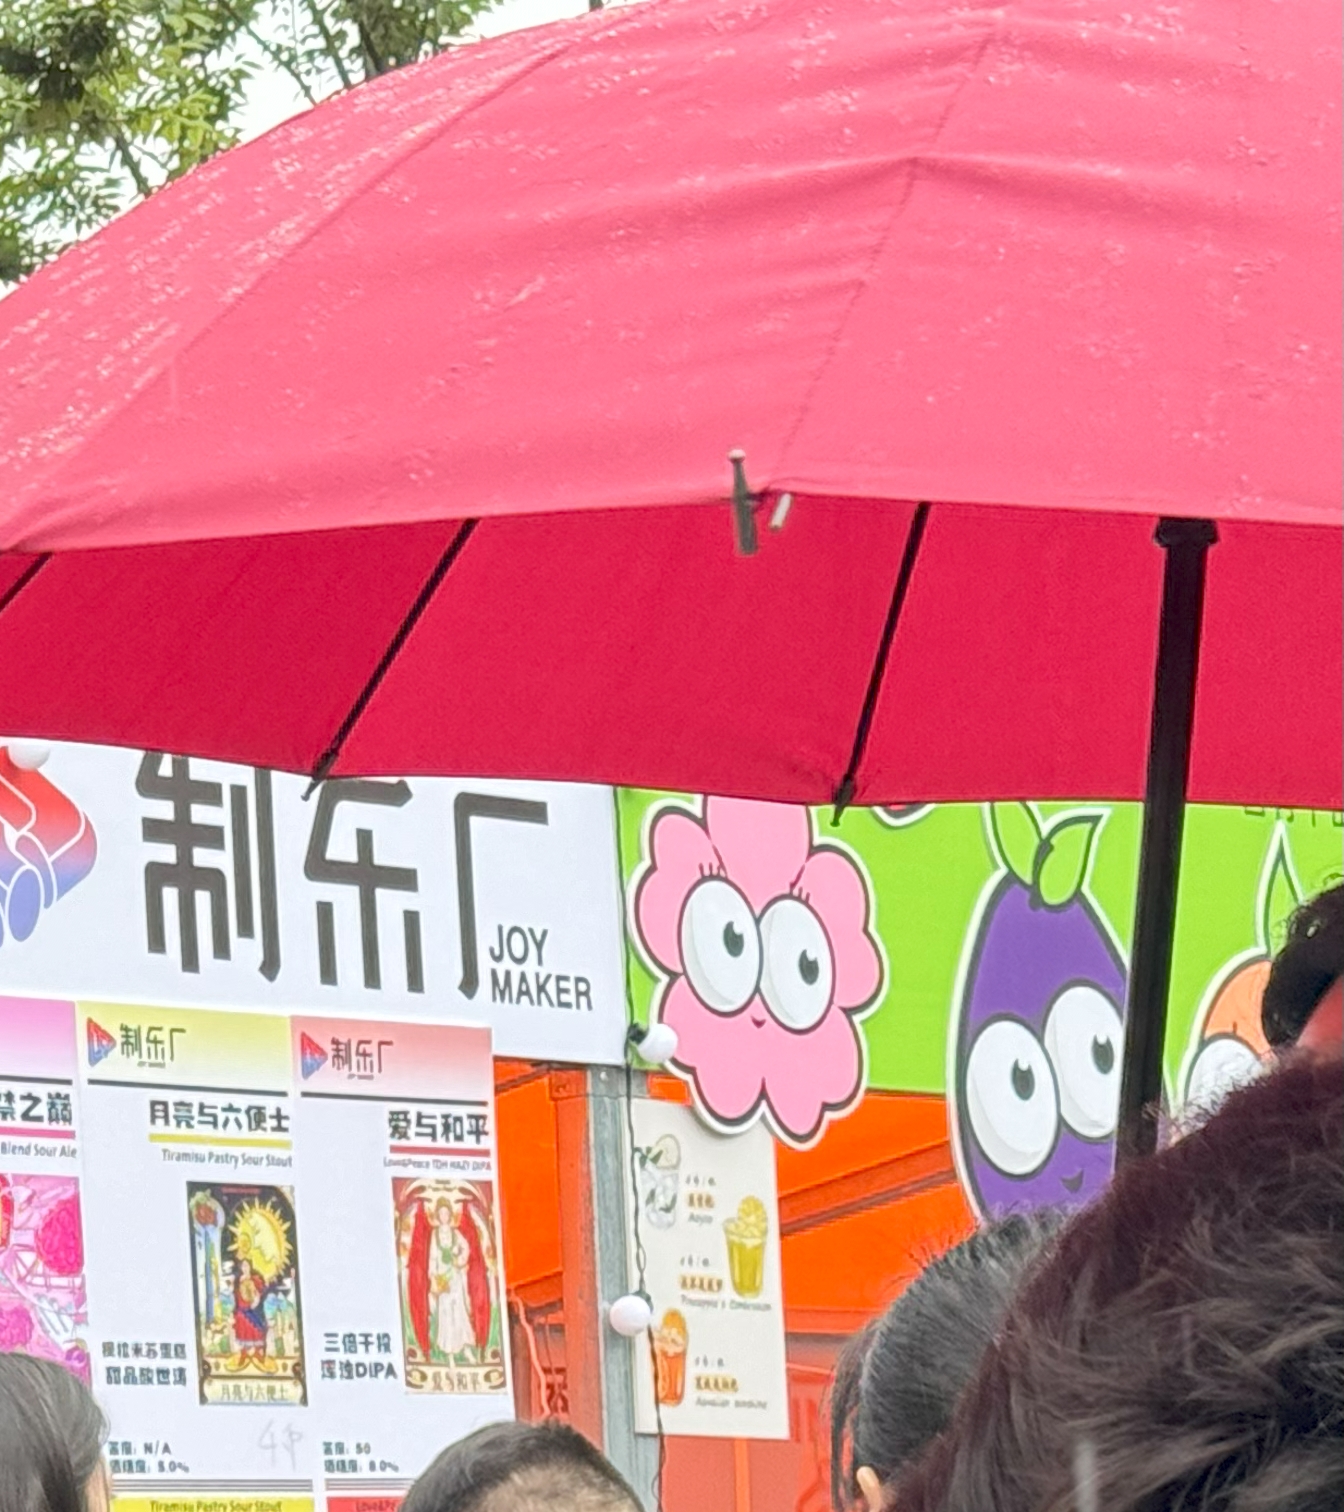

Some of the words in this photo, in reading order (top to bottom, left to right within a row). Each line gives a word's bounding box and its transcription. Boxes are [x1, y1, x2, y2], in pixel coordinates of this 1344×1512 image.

[135, 750, 550, 994] 制乐厂
[491, 926, 547, 968] JOY
[490, 968, 594, 1011] MAKER
[120, 1023, 187, 1061] 制乐厂
[331, 1037, 394, 1074] 制乐厂
[149, 1100, 290, 1132] 月亮与六便士
[388, 1110, 490, 1145] 爱与和平
[0, 1141, 31, 1156] Blend
[33, 1144, 57, 1157] Sour
[59, 1145, 77, 1158] Ale
[162, 1149, 205, 1163] Tiramisu
[208, 1152, 239, 1169] Pastry
